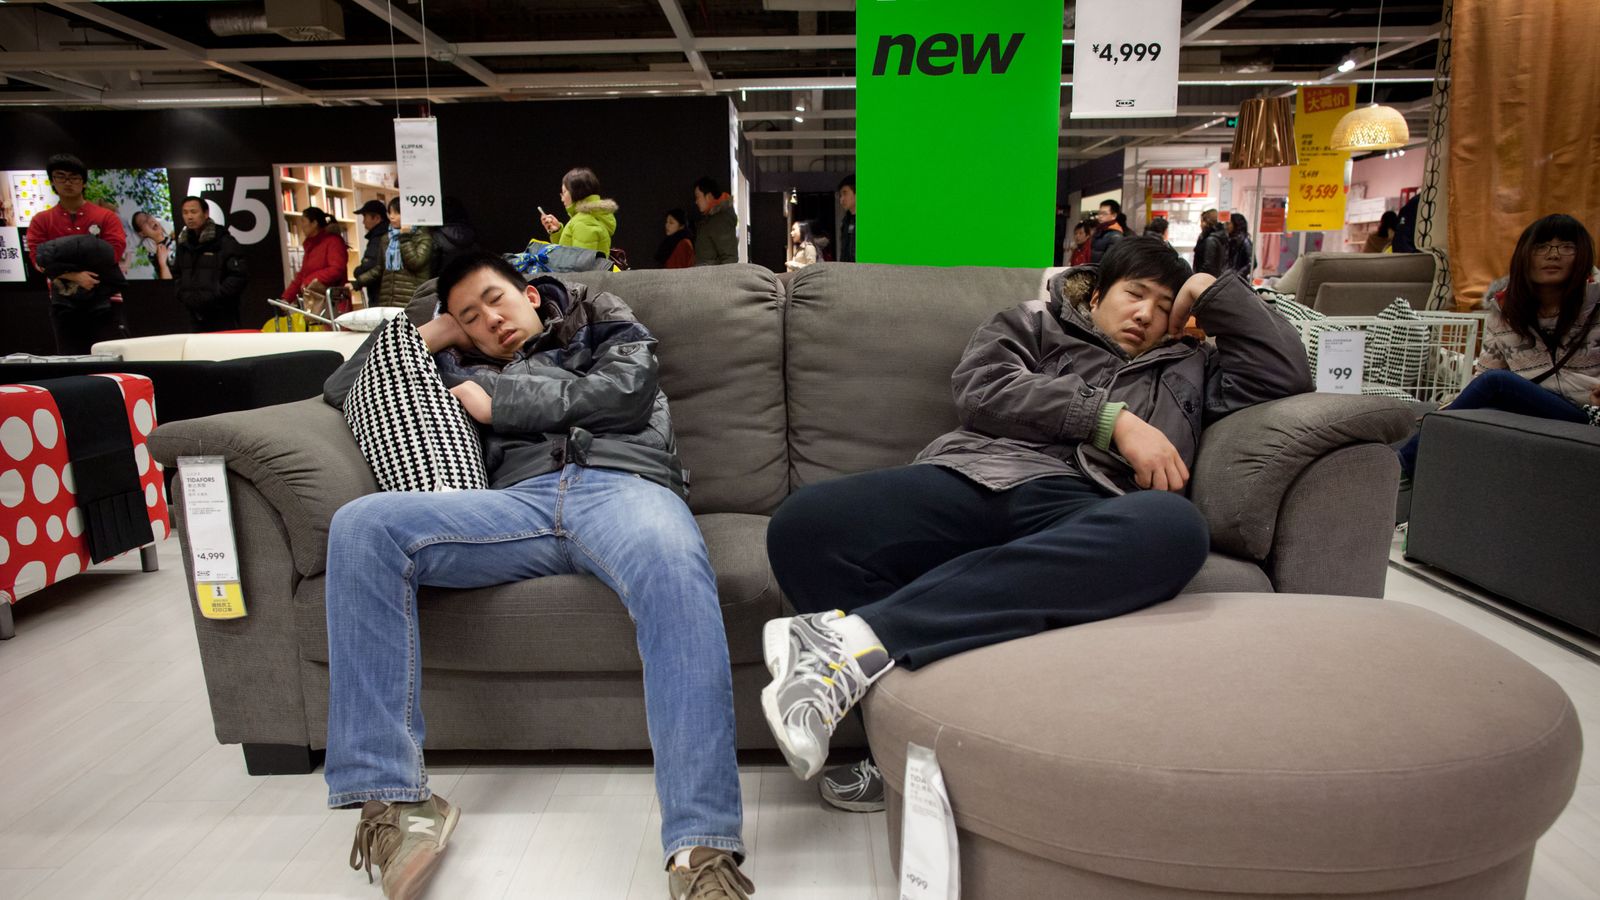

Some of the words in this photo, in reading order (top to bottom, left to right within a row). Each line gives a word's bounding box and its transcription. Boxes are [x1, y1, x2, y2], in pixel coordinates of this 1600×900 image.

[872, 32, 1025, 76] new
[1092, 43, 1161, 66] ¥4,999
[405, 195, 435, 207] ¥999
[1300, 184, 1338, 202] ¥3,599
[1329, 367, 1352, 380] ¥99
